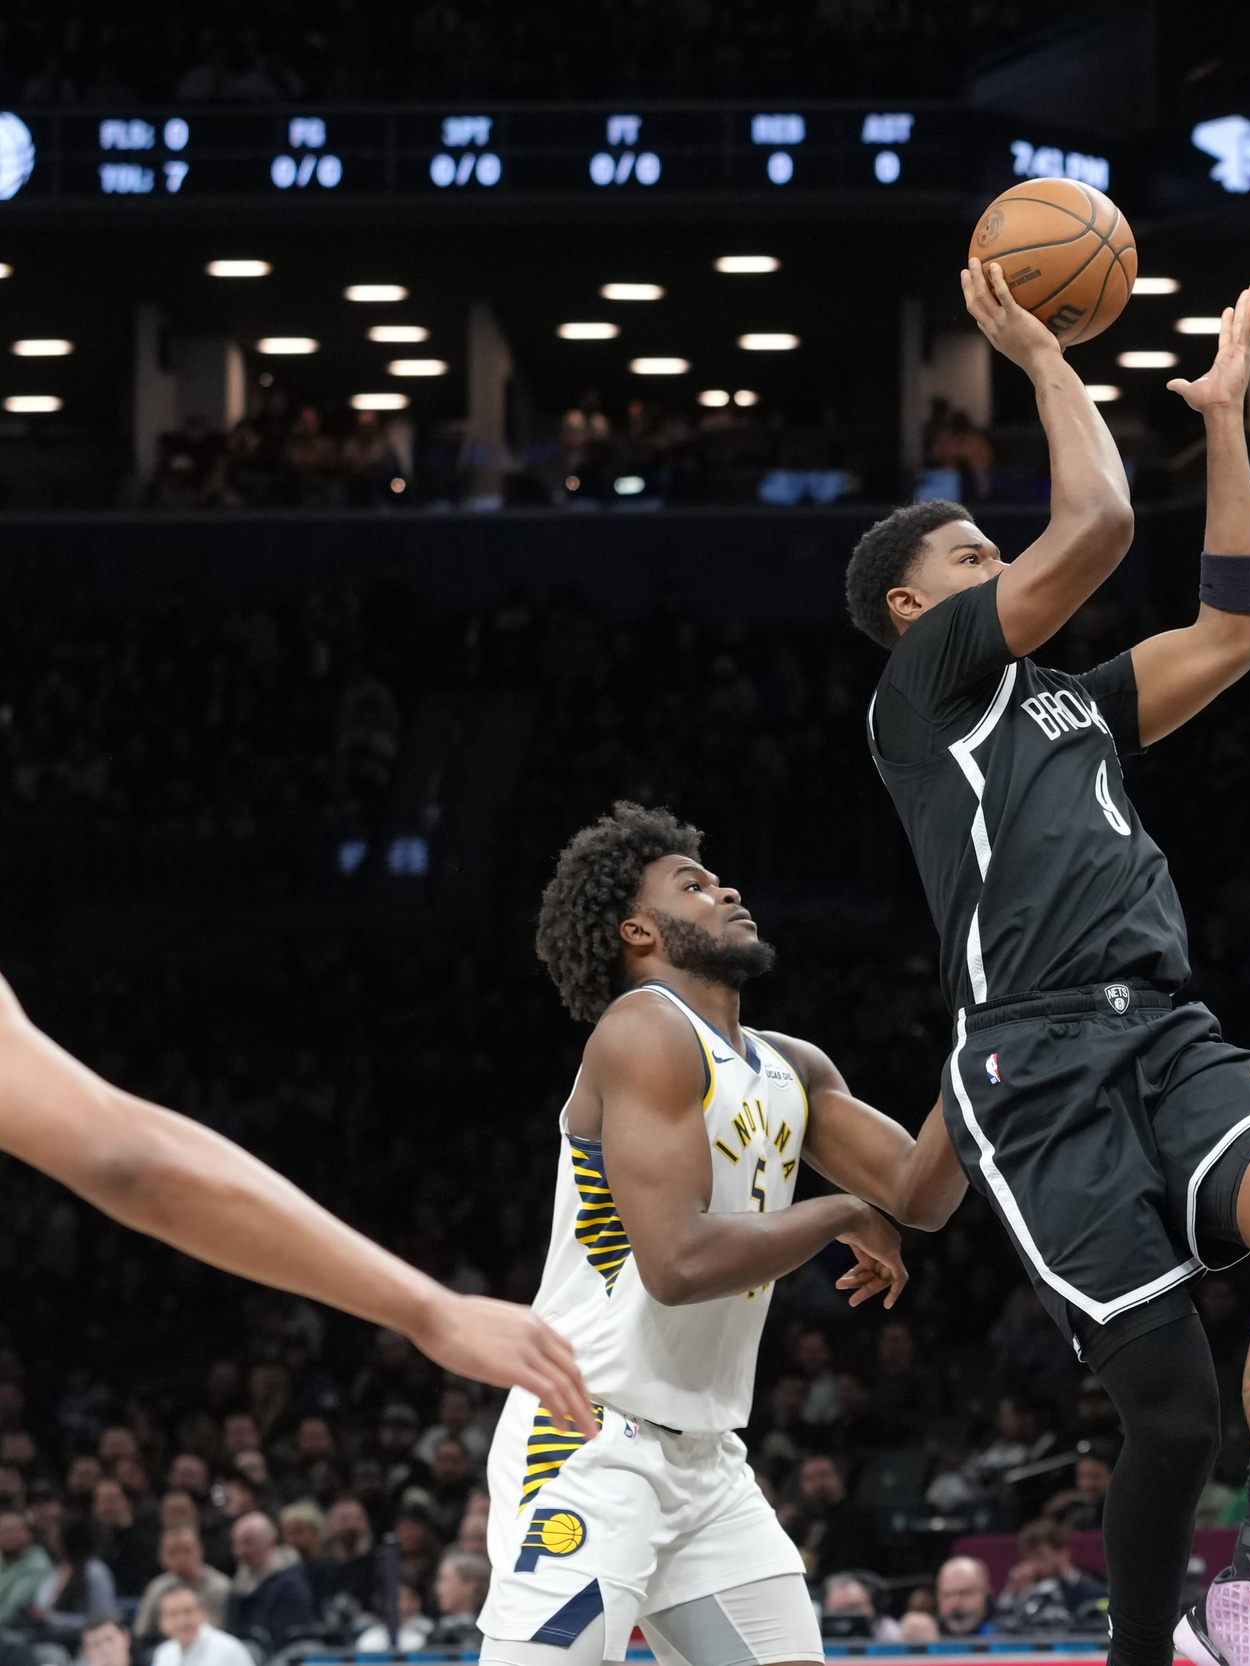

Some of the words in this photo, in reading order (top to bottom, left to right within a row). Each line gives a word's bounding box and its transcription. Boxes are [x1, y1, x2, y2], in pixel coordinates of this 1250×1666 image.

[164, 117, 189, 151] 0
[163, 160, 189, 193] 7
[271, 153, 343, 189] 0/0
[429, 152, 502, 187] 0/0
[589, 151, 661, 186] 0/0
[767, 151, 793, 185] 0
[874, 150, 900, 184] 0
[1107, 987, 1128, 999] NETS
[714, 1099, 796, 1182] INDINA
